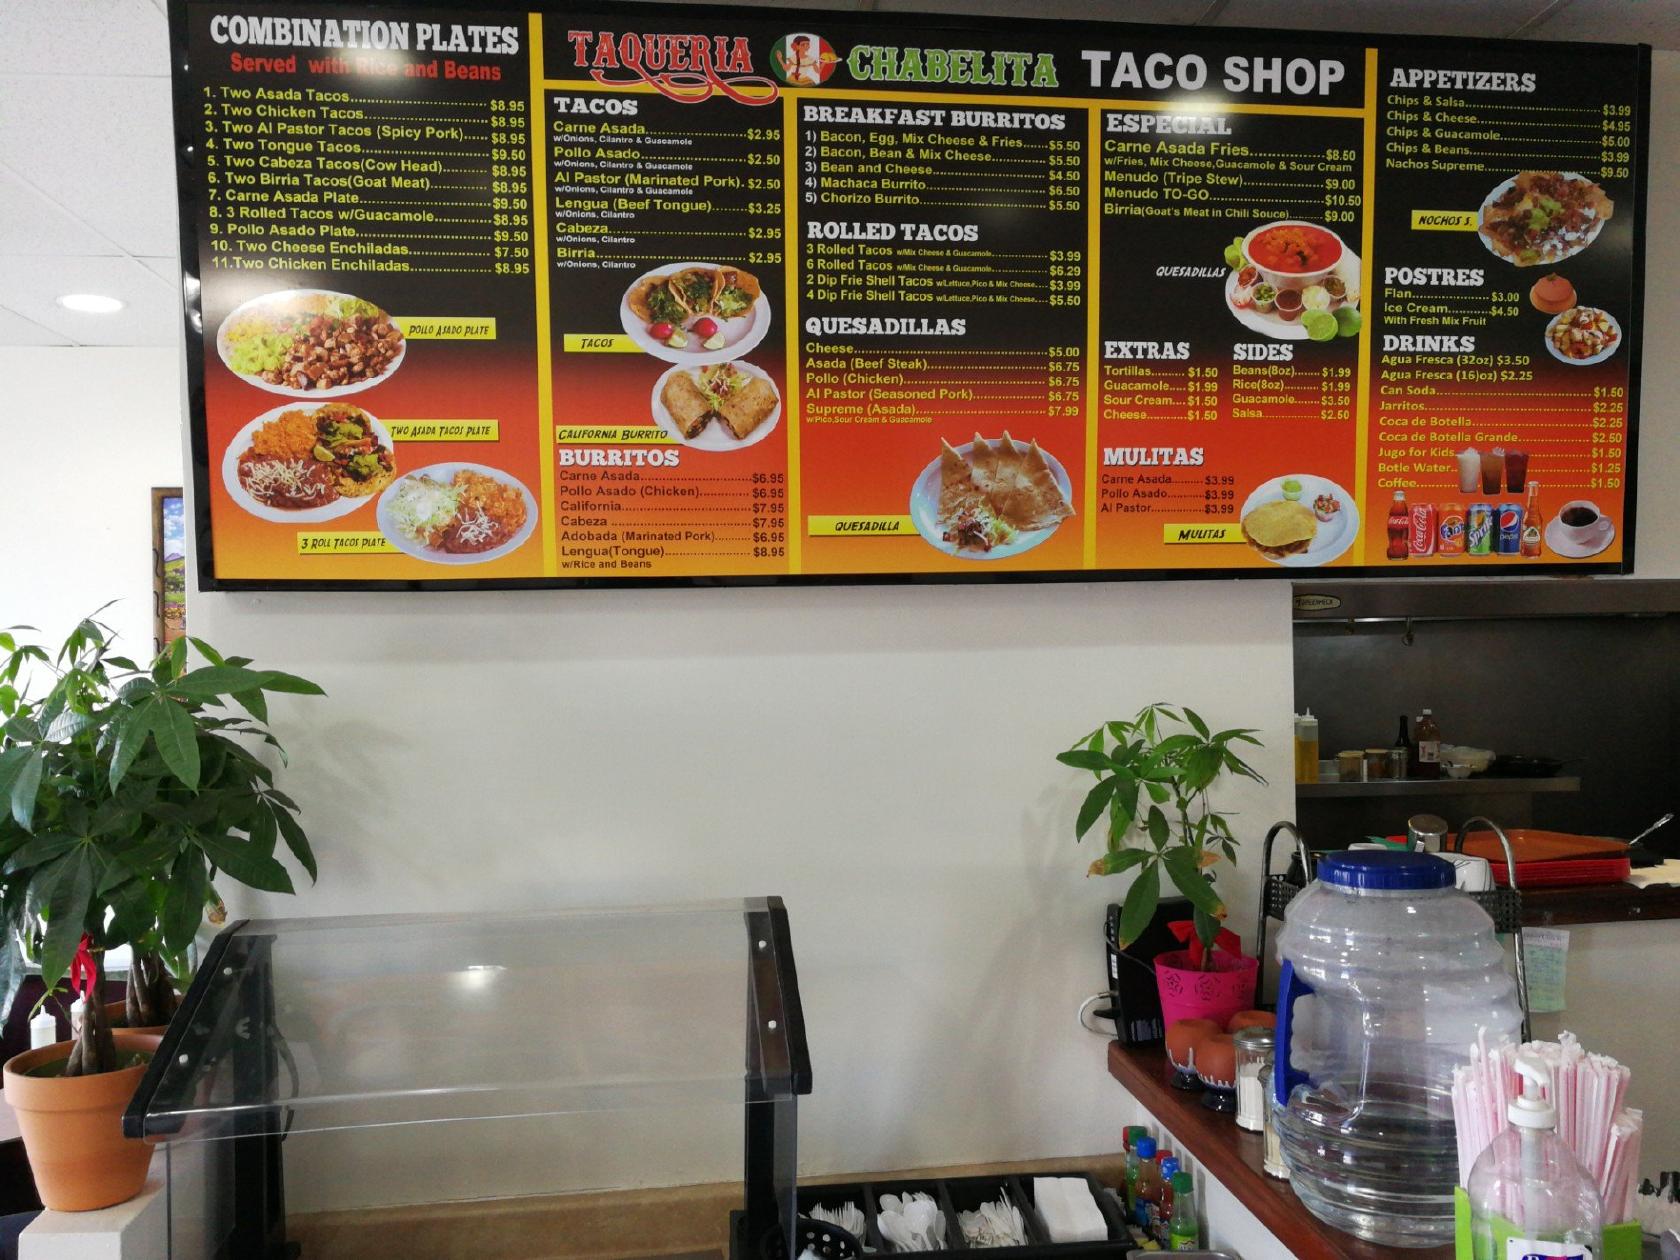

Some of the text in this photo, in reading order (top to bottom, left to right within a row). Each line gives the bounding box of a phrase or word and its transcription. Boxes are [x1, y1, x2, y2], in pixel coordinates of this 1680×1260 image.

[210, 15, 519, 55] COMBINATION PLATES
[230, 52, 502, 81] Served with Rice and Beans
[568, 30, 766, 92] TAQUERIA
[847, 45, 1059, 88] CHABELITA
[1081, 50, 1345, 96] TACO SHOP
[1390, 68, 1536, 93] APPETIZERS
[203, 87, 216, 98] 1.
[220, 87, 251, 99] Two
[256, 88, 301, 101] Asada
[490, 100, 525, 113] $8.95
[554, 97, 638, 116] TACOS
[1387, 95, 1419, 108] Chips
[1423, 97, 1432, 106] &
[1603, 105, 1631, 117] $3.99
[803, 106, 1066, 130] BREAKFAST BURRITOS
[1107, 113, 1232, 135] ESPECIAL
[205, 121, 218, 134] 3.
[222, 121, 253, 134] Two
[257, 122, 273, 134] Al
[277, 123, 325, 136] Pastor
[329, 124, 372, 137] Tacos
[377, 125, 421, 141] (Spicy
[491, 133, 526, 145] $8.95
[553, 121, 596, 134] Carne
[747, 128, 780, 140] $2.95
[600, 135, 633, 144] Cilantro
[636, 136, 643, 144] &
[645, 137, 693, 146] Guacamole
[1104, 140, 1150, 153] Carne
[1156, 141, 1205, 155] Asada
[804, 161, 817, 173] 3)
[820, 162, 854, 173] Bean
[858, 162, 882, 174] and
[1049, 170, 1080, 181] $4.50
[1386, 159, 1429, 170] Nachos
[1601, 167, 1629, 178] $9.50
[804, 177, 817, 189] 4)
[820, 177, 878, 189] Machaca
[1049, 185, 1080, 196] $6.50
[1104, 170, 1158, 183] Menudo
[1163, 172, 1201, 186] (Tripe
[1325, 179, 1356, 191] $9.00
[209, 190, 222, 201] 7.
[225, 190, 269, 203] Carne
[273, 191, 319, 203] Asada
[493, 199, 527, 210] $9.50
[556, 197, 608, 211] Lengua
[613, 197, 651, 212] (Beef
[748, 203, 781, 215] $3.25
[804, 192, 817, 204] 5)
[820, 192, 871, 204] Chorizo
[1049, 200, 1080, 211] $5.50
[1418, 215, 1461, 226] NOCHOS
[748, 228, 781, 239] $2.95
[807, 221, 978, 242] ROLLED TACOS
[268, 258, 327, 270] Chicken
[495, 263, 529, 274] $8.95
[1156, 266, 1226, 278] QUESADILLAS
[806, 275, 813, 285] 2
[817, 275, 837, 289] Dip
[840, 275, 862, 286] Frie
[865, 275, 895, 286] Shell
[1049, 280, 1080, 291] $3.99
[1384, 267, 1485, 286] POSTRES
[1491, 292, 1519, 302] $3.00
[1384, 302, 1404, 313] Ice
[1491, 306, 1519, 317] $4.50
[408, 324, 489, 336] POLLO ASADO PLATE
[805, 316, 966, 336] QUESADILLAS
[581, 338, 614, 349] TACOS
[1048, 347, 1080, 357] $5.00
[1104, 341, 1190, 360] EXTRAS
[1233, 343, 1294, 361] SIDES
[1383, 334, 1476, 353] DRINKS
[805, 358, 846, 369] Asada
[850, 357, 884, 371] (Beef
[1048, 362, 1080, 372] $6.75
[1381, 355, 1529, 367] Agua Fresca (32oz) $3.50
[1187, 367, 1218, 378] $1.50
[1322, 367, 1351, 378] $1.99
[1380, 385, 1403, 395] Can
[1593, 387, 1624, 398] $1.50
[391, 425, 490, 437] TWO ASADA TACOS PLATE
[558, 429, 668, 440] CALIFORNIA BURRITO
[559, 449, 680, 467] BURRITOS
[1103, 447, 1204, 467] MULITAS
[559, 470, 596, 481] Carne
[752, 473, 784, 484] $6.95
[1101, 474, 1134, 484] Carne
[1204, 475, 1234, 485] $3.99
[752, 503, 784, 514] $7.95
[835, 520, 900, 532] QUESADILLA
[1178, 528, 1226, 540] MULITAS
[301, 536, 386, 550] 3 ROLL TACOS PLATE
[561, 559, 652, 569] w/Rice and Beans
